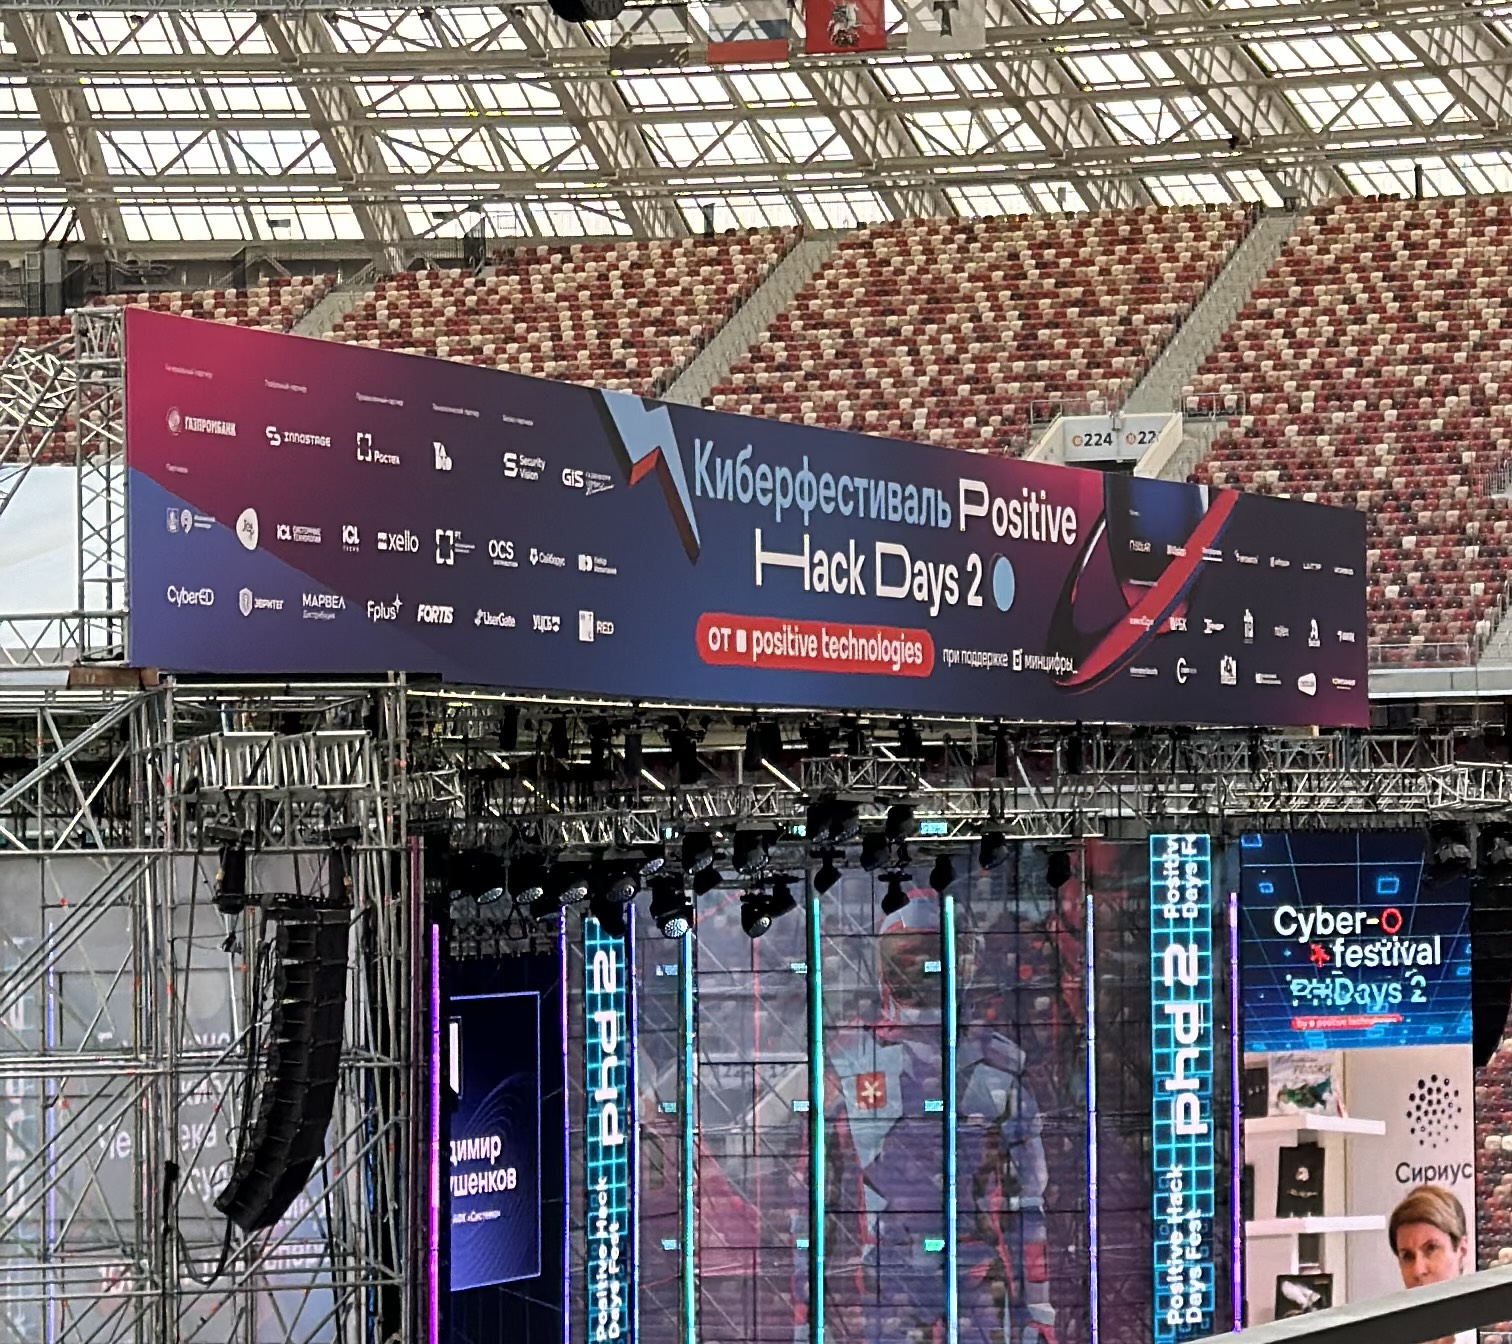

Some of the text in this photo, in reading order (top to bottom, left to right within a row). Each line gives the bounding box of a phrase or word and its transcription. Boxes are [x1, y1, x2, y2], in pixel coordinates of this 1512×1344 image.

[184, 415, 237, 437] ГАЗПРОМБАНК
[1083, 432, 1113, 447] 224
[1137, 430, 1160, 445] 22
[519, 454, 546, 472] Security
[519, 467, 540, 481] Vision
[693, 438, 1079, 546] Киберфестиваль Positive
[388, 529, 420, 554] xello
[488, 538, 515, 560] OCS
[754, 527, 984, 618] Hack Days 2
[416, 603, 455, 625] FORTIS
[751, 624, 818, 663] positive
[821, 626, 924, 672] technologies
[943, 648, 960, 668] при
[961, 649, 1009, 671] поддержке
[1163, 943, 1199, 987] 2
[1330, 934, 1441, 968] festival
[593, 949, 617, 994] 2
[1409, 974, 1427, 1003] 2
[1395, 1159, 1473, 1187] Сириус
[1167, 1163, 1184, 1326] Positive Hack
[1185, 1266, 1203, 1325] Days
